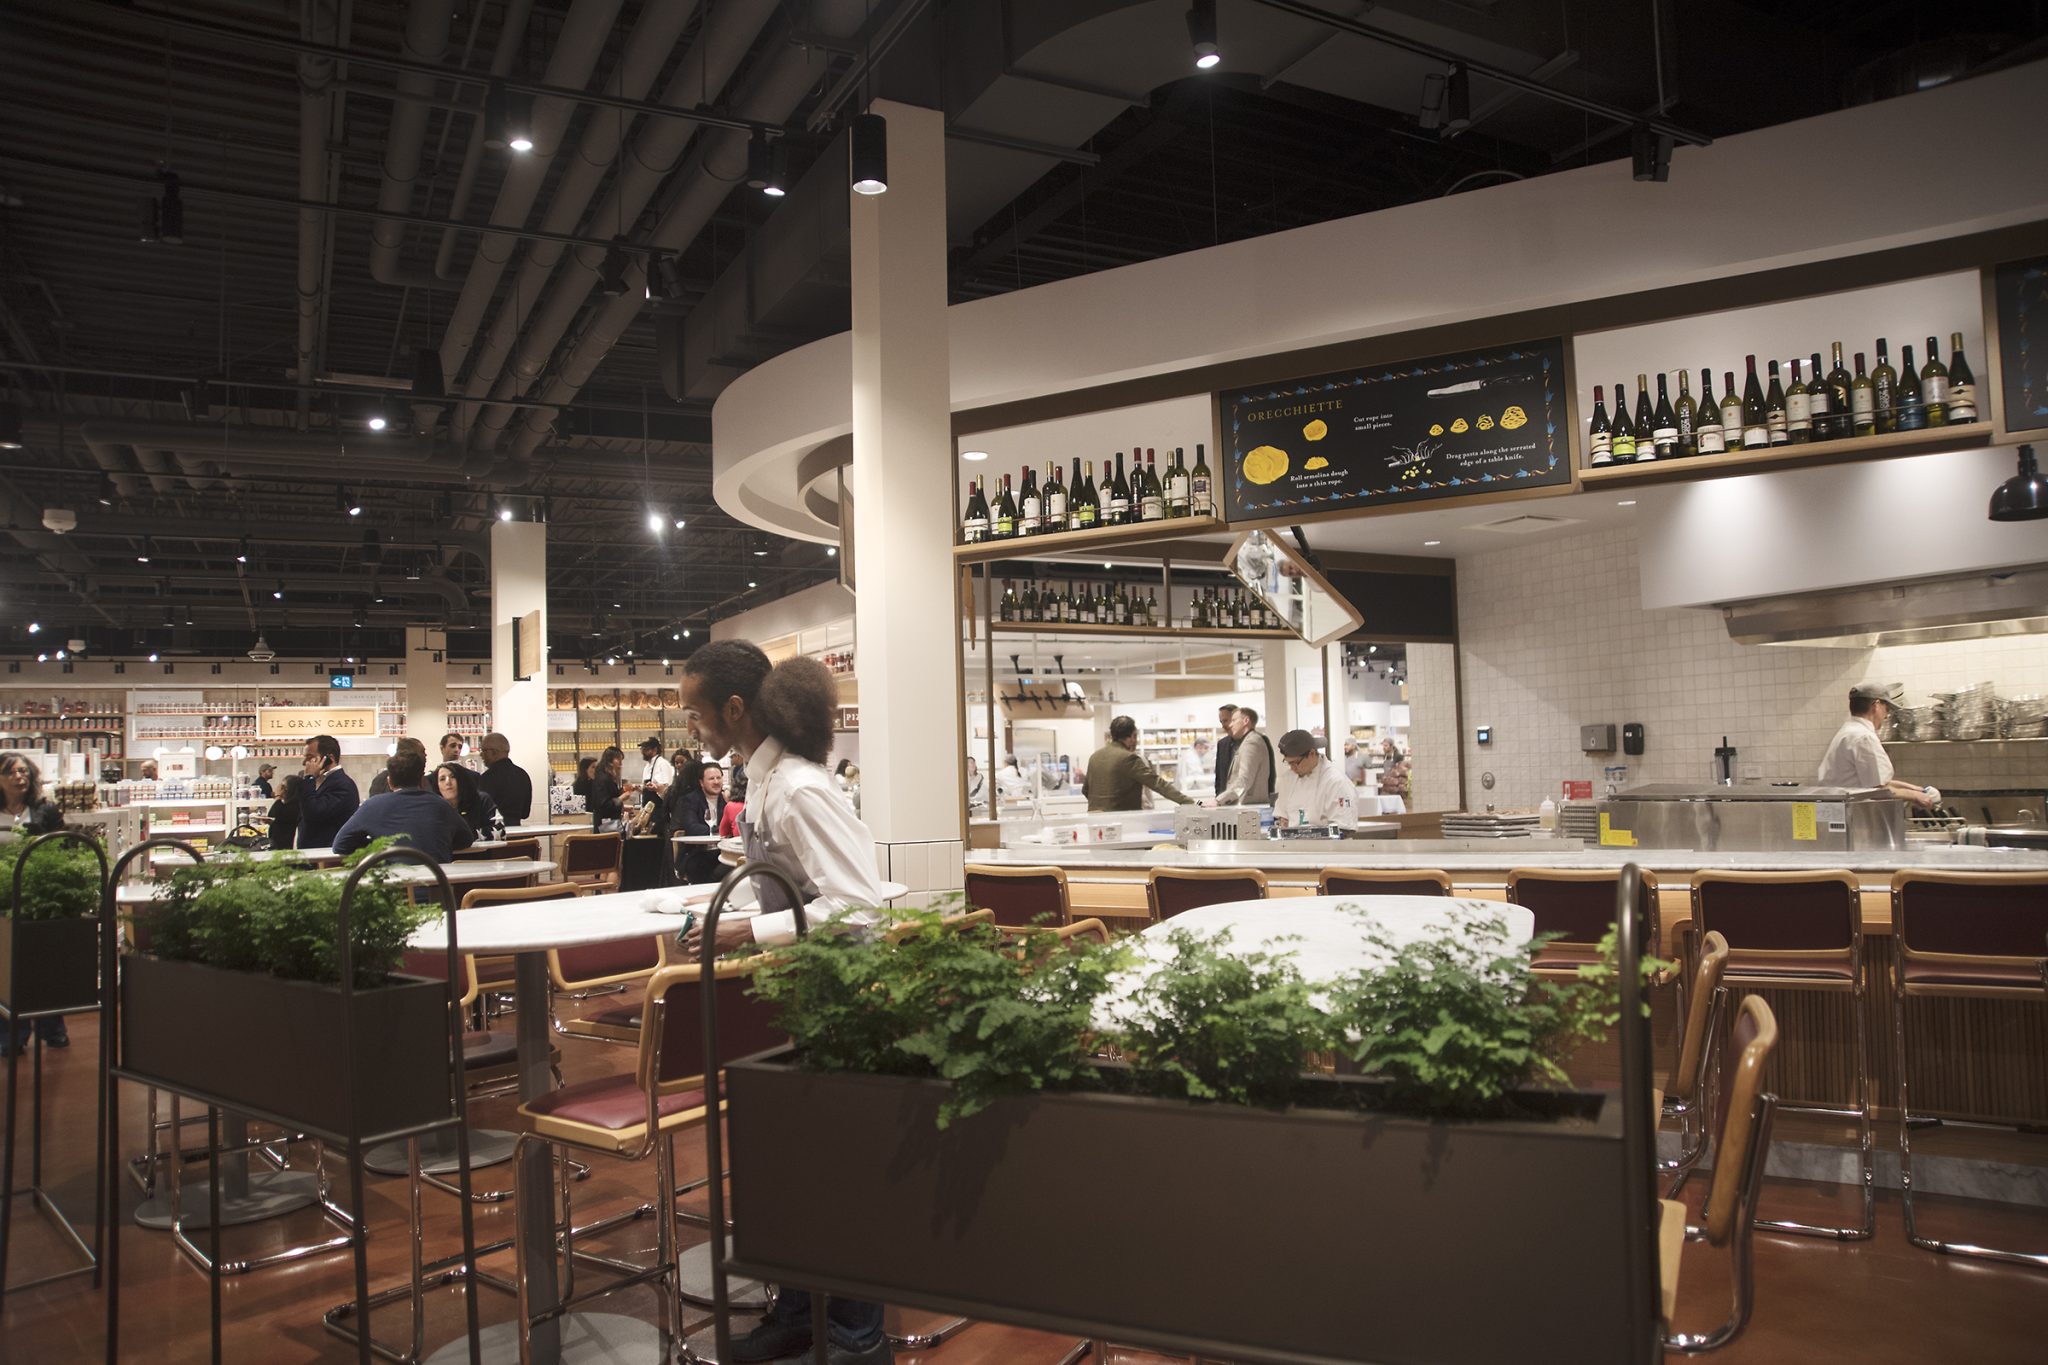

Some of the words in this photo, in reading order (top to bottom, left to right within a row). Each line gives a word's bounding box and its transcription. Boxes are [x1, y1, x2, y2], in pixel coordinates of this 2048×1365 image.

[1247, 399, 1343, 422] ORECCHIETTE
[1372, 421, 1392, 430] pieces.
[1462, 451, 1479, 459] pasta
[1480, 448, 1498, 456] along
[1510, 442, 1536, 452] serrated
[1505, 453, 1524, 461] knife.
[1290, 474, 1303, 482] Roll
[1304, 471, 1330, 480] semolina
[1330, 468, 1349, 477] dough
[270, 720, 284, 728] IL
[288, 720, 322, 728] GRAN
